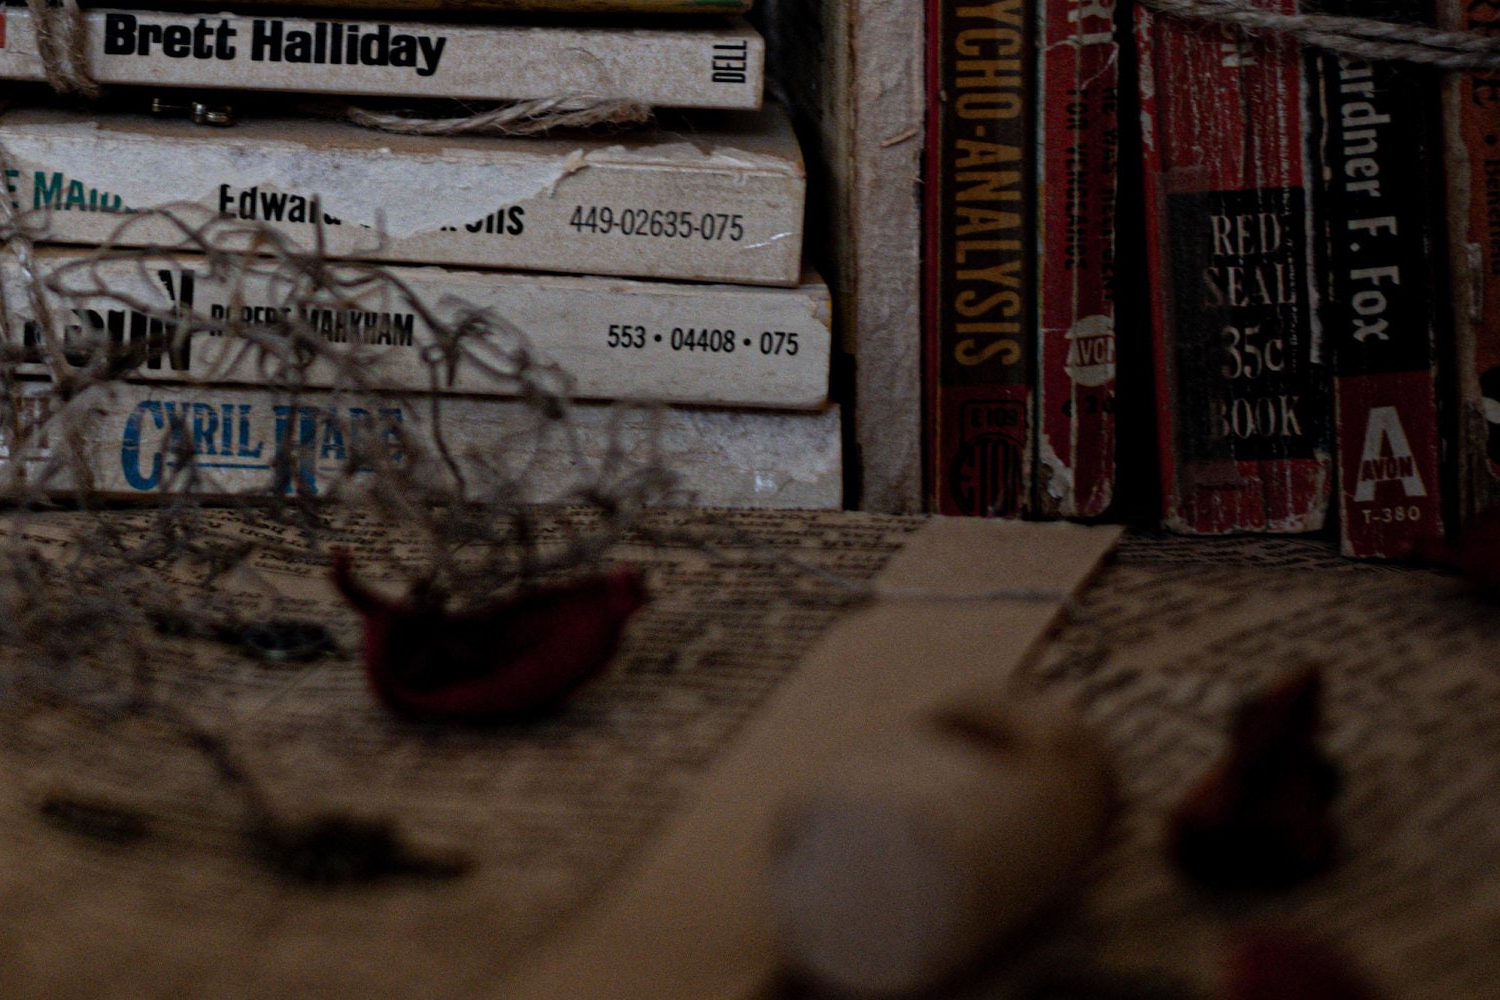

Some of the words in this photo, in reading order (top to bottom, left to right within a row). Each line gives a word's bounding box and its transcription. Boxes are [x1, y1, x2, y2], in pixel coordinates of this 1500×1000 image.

[104, 13, 237, 61] Brett
[251, 18, 446, 76] Halliday
[712, 40, 747, 83] DELL
[1338, 58, 1391, 198] ardner
[219, 184, 342, 226] Edwar
[570, 205, 743, 242] 449-02635-075
[1210, 212, 1282, 256] RED
[1347, 215, 1398, 252] F.
[1202, 262, 1295, 308] SEAL
[1348, 265, 1400, 341] Fox
[606, 325, 646, 349] 553
[669, 329, 735, 353] 04408
[760, 331, 799, 356] 075
[1208, 395, 1303, 439] BOOK
[1362, 456, 1413, 481] AVON
[1362, 506, 1421, 523] T-380
